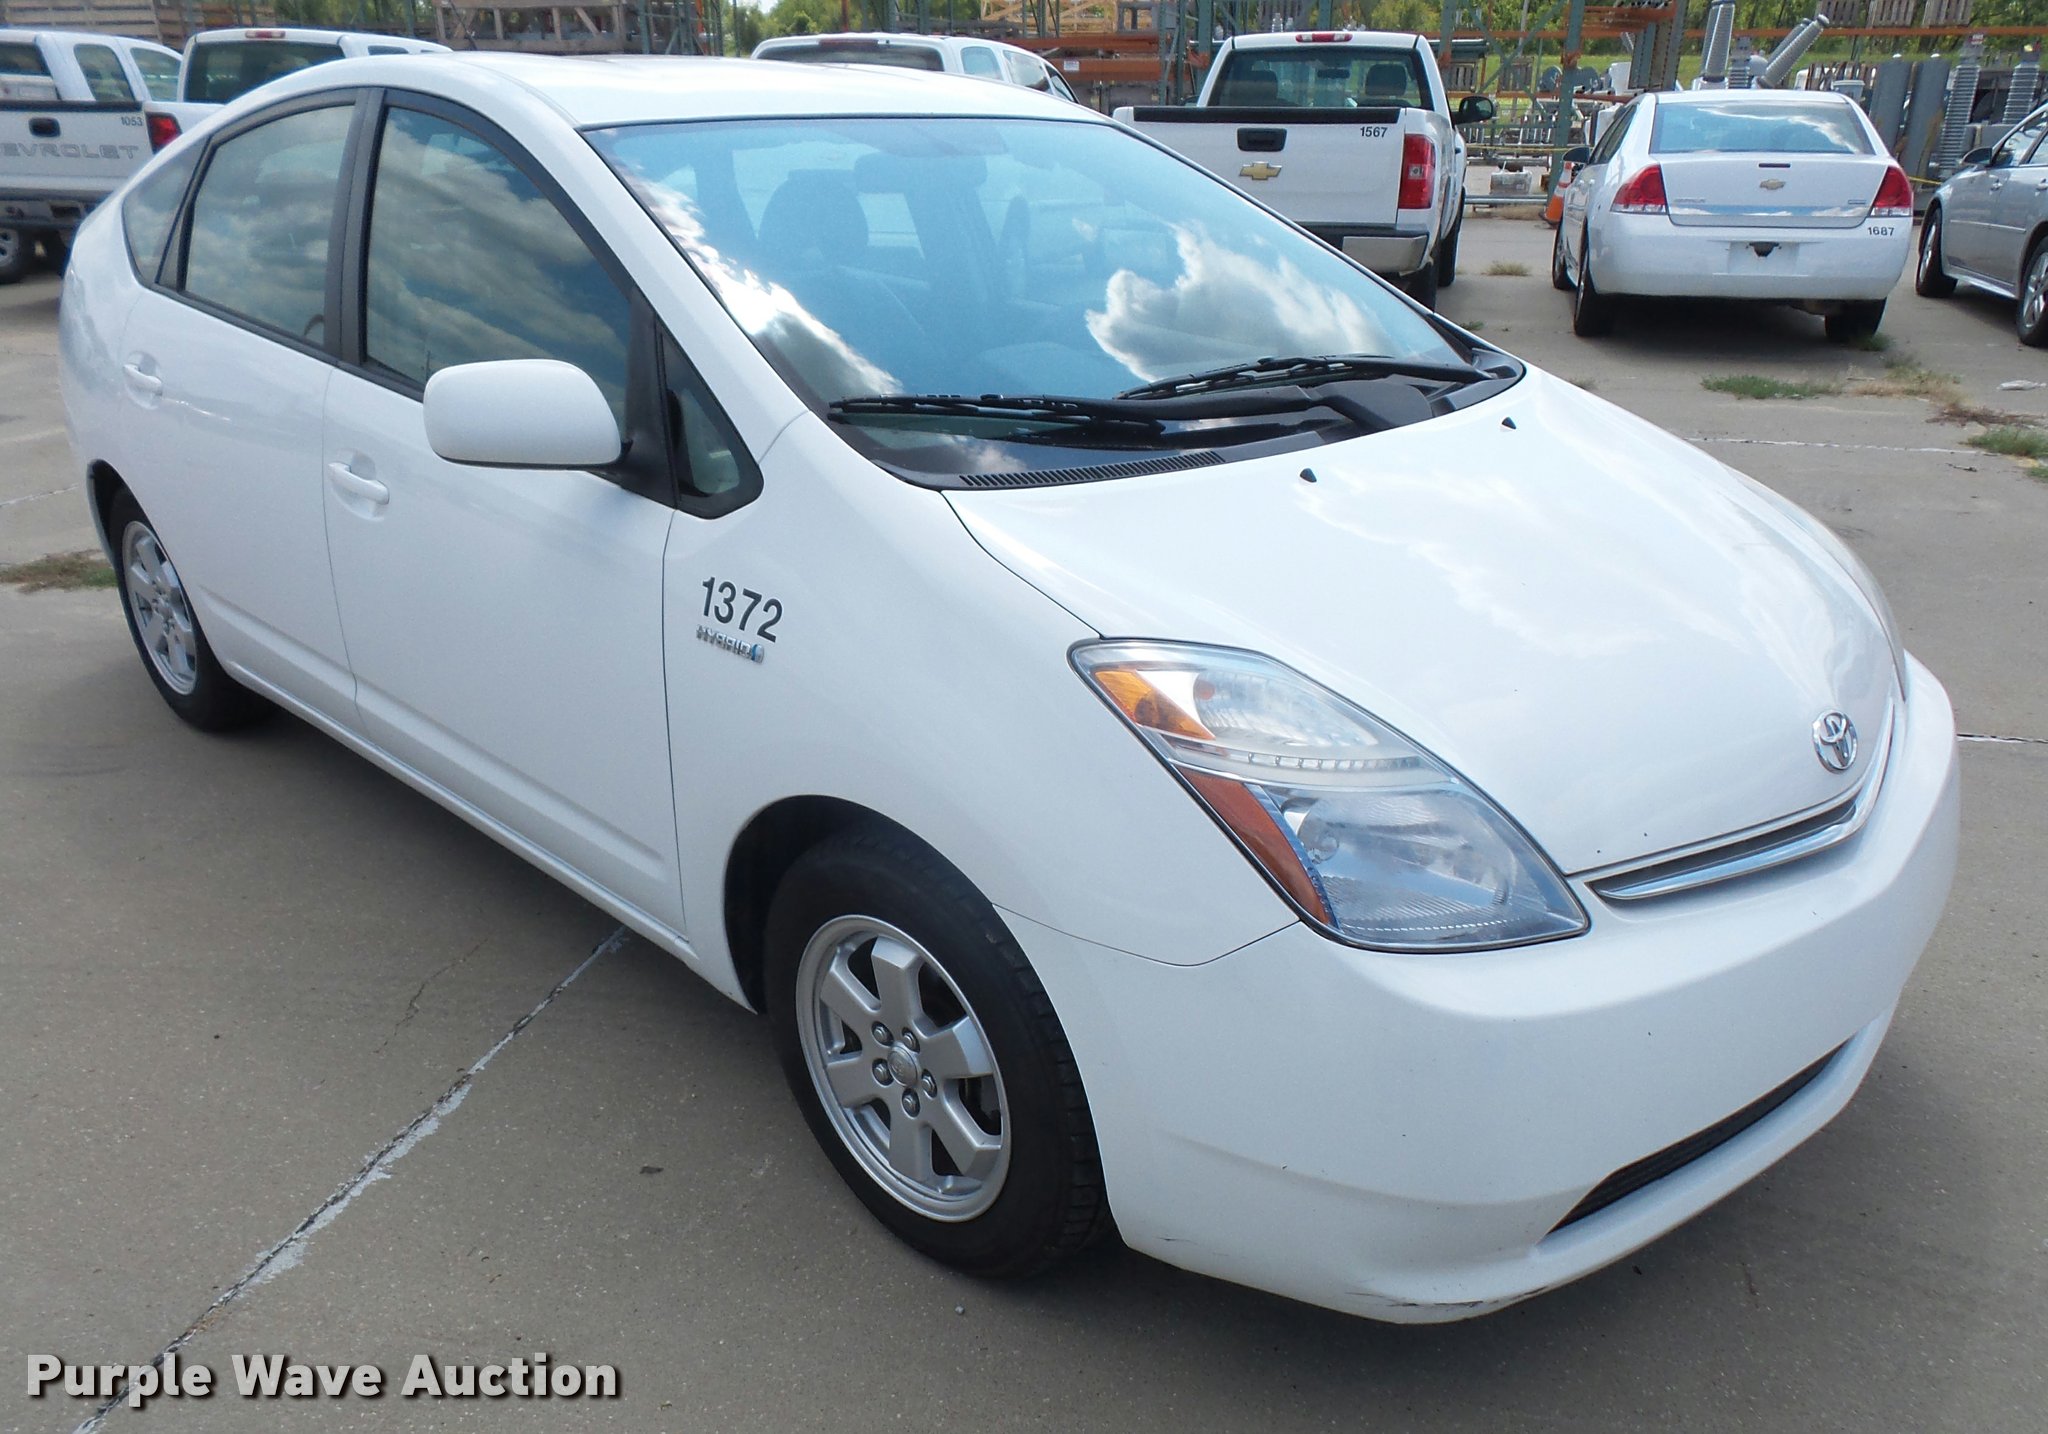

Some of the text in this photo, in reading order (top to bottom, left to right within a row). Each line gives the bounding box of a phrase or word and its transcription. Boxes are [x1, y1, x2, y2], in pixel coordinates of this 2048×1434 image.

[121, 116, 143, 126] 1053
[1360, 126, 1388, 138] 1567
[1867, 226, 1895, 236] 1687
[702, 576, 783, 643] 1372
